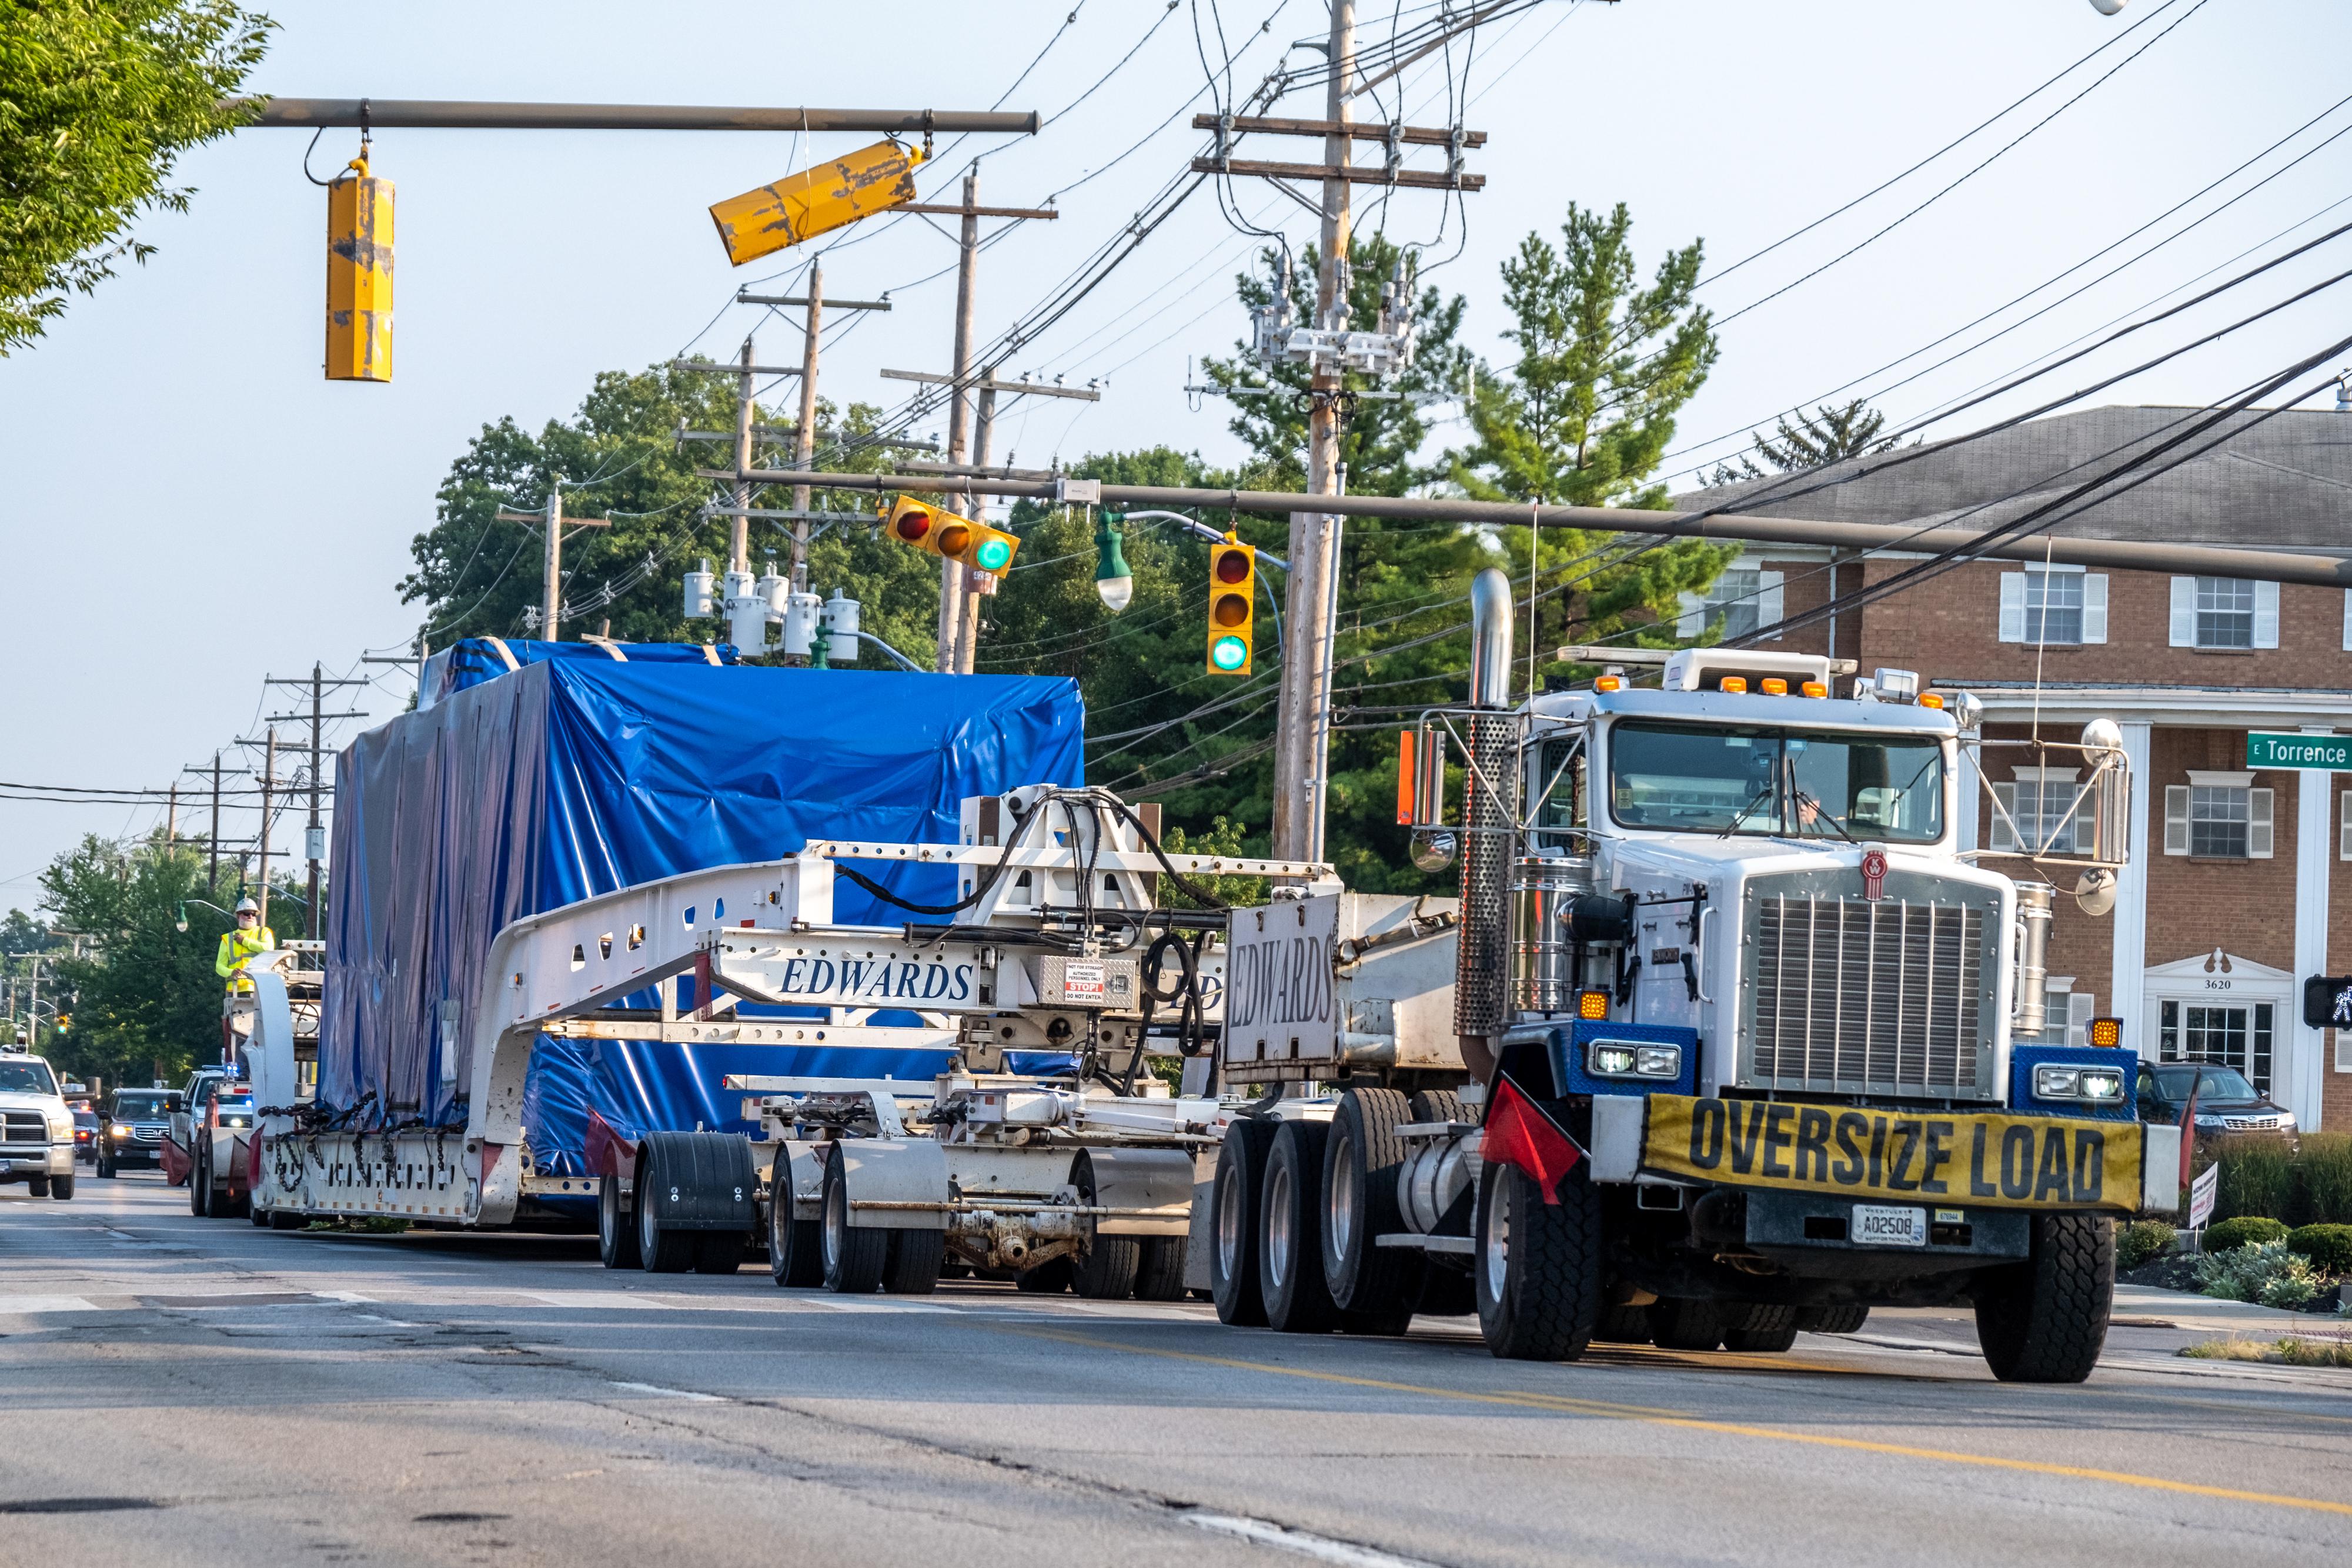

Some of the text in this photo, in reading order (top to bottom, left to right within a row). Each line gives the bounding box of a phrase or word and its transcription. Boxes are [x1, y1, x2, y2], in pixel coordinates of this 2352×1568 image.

[2254, 740, 2346, 763] E Torrence
[777, 958, 974, 1000] EDWARDS
[1070, 982, 1099, 992] STOP!
[1230, 927, 1334, 1028] EDWARDS
[2205, 979, 2231, 989] 3620
[1689, 1098, 1954, 1194] OVERSIZE
[1970, 1122, 2105, 1202] LOAD
